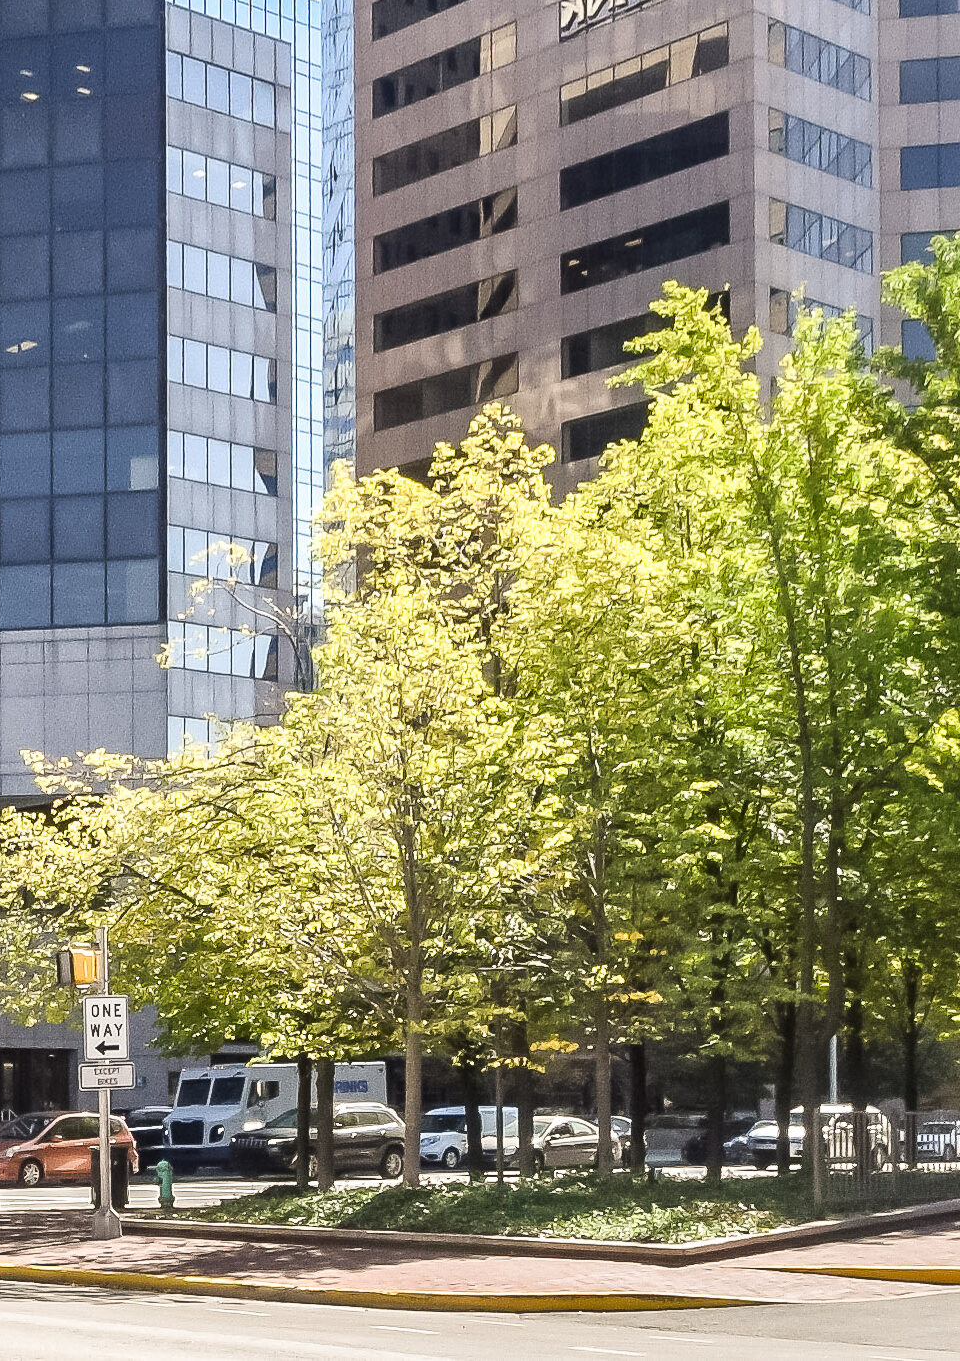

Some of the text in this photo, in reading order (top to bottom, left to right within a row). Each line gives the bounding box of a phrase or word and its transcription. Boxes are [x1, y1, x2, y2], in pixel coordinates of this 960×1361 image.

[91, 1004, 122, 1018] ONE
[90, 1024, 123, 1038] WAY
[334, 1080, 368, 1093] RINKS
